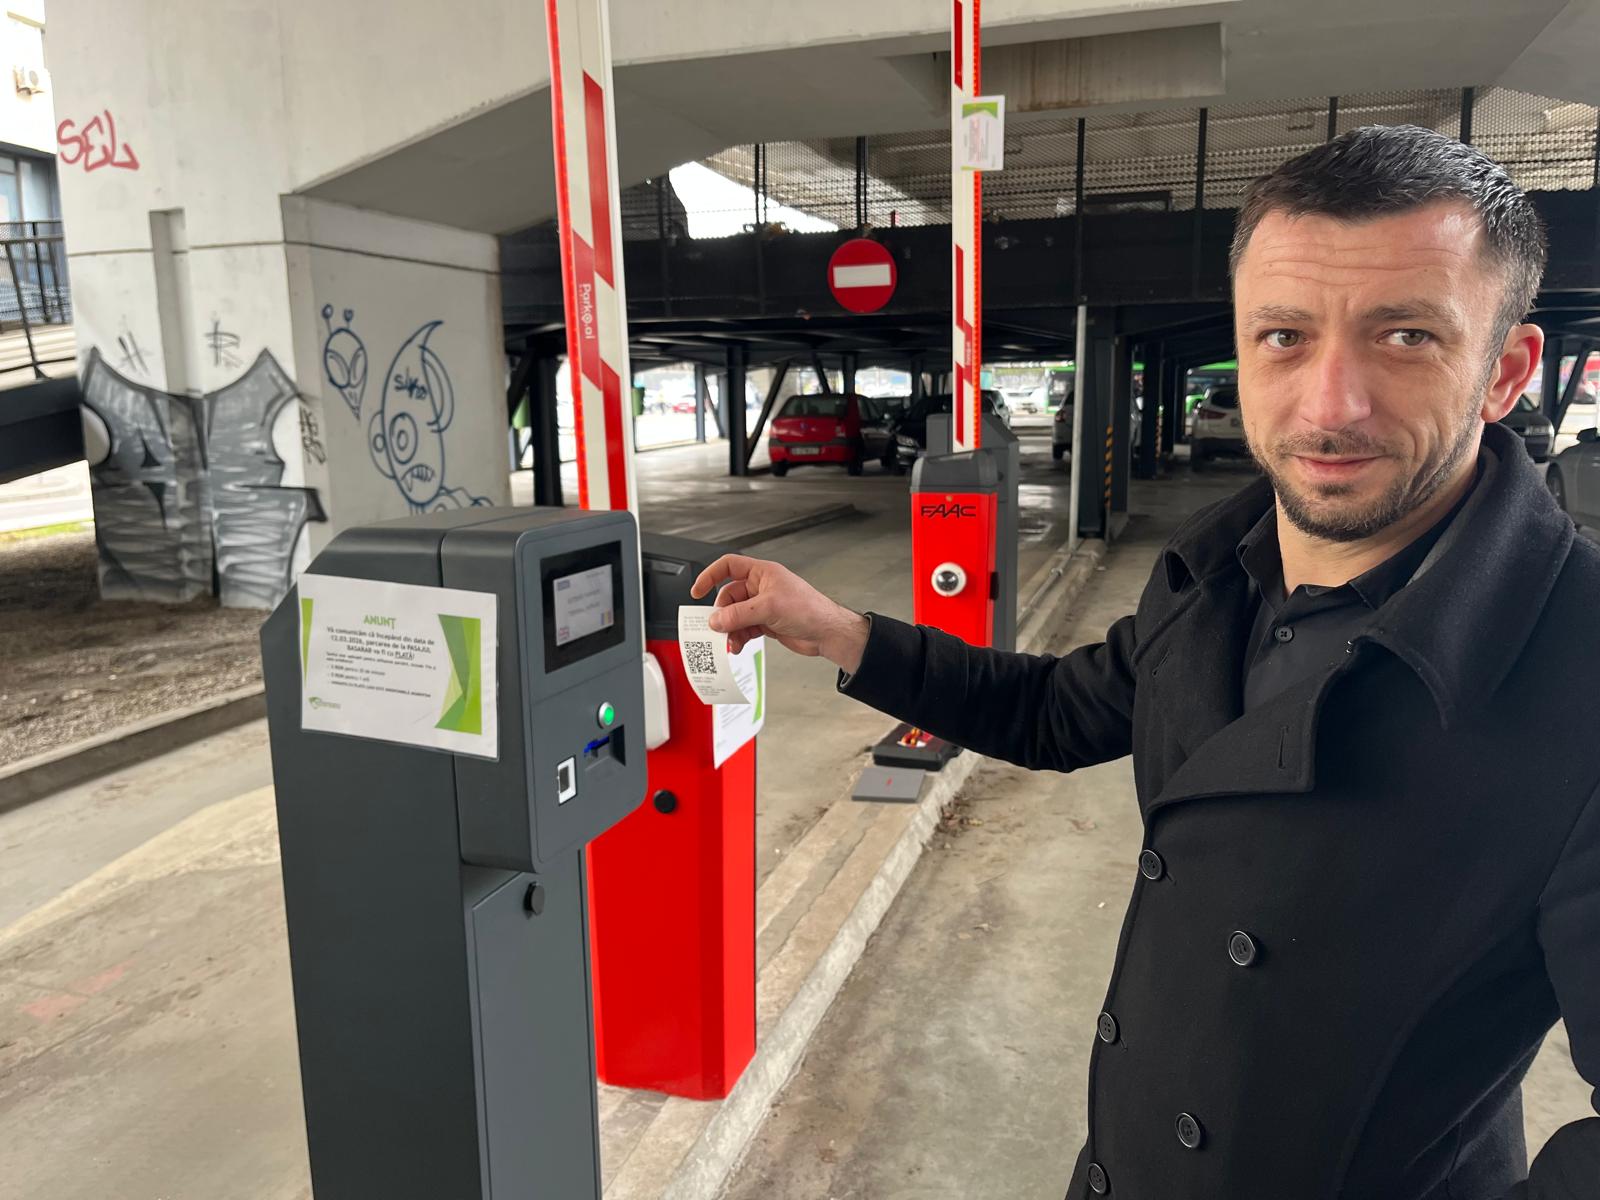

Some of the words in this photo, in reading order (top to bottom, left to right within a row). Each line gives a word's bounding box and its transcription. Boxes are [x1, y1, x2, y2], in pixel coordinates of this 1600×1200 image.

[920, 503, 977, 519] FAAC
[366, 639, 391, 649] parcarea
[407, 644, 431, 654] PASAJUL
[413, 637, 426, 645] data
[347, 644, 372, 654] BASARAB
